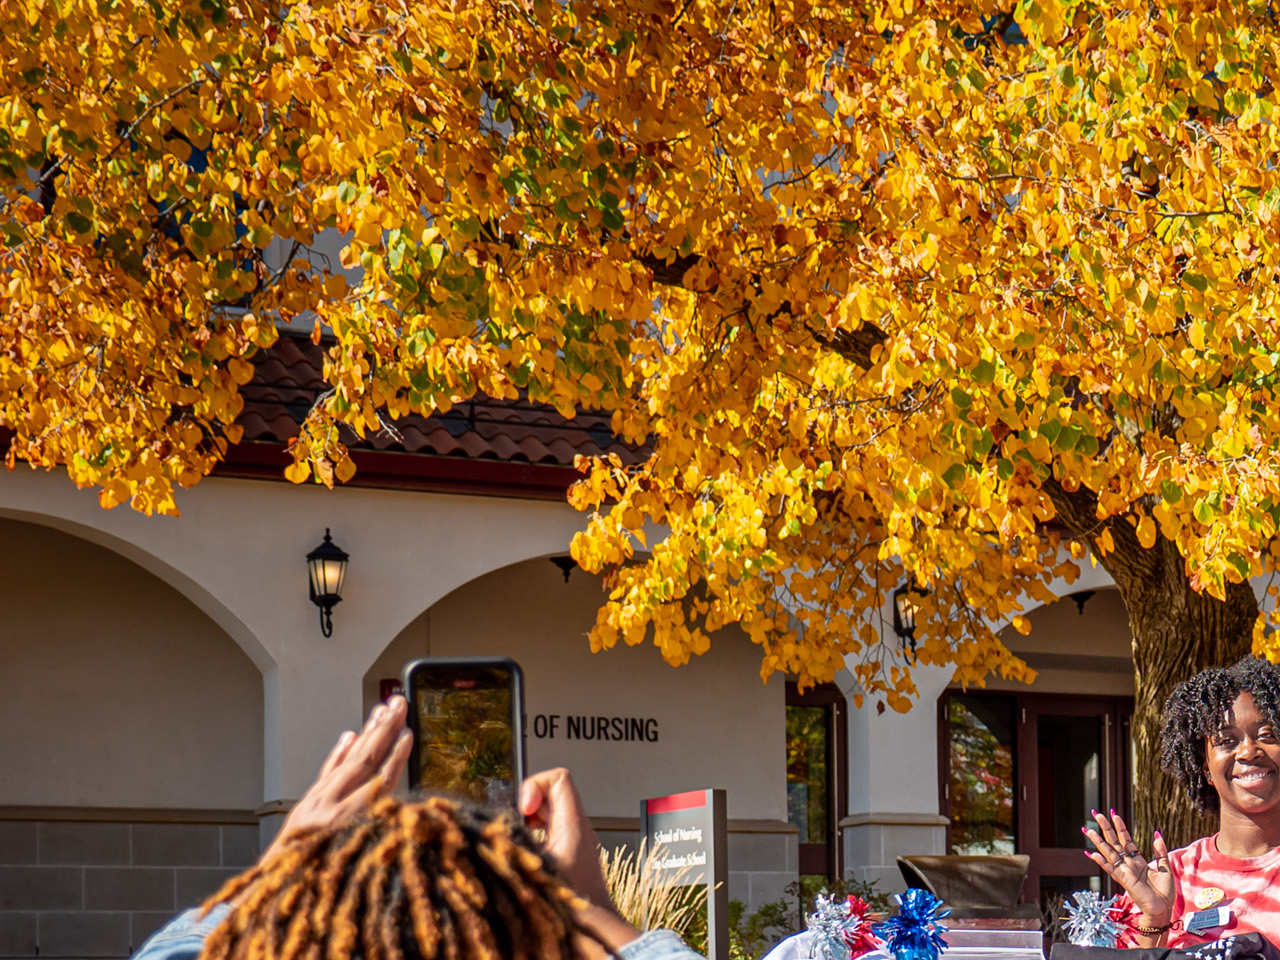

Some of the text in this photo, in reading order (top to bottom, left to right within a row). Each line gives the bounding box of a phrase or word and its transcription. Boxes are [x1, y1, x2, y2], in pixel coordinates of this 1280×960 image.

[534, 714, 560, 739] OF
[566, 715, 660, 743] NURSING
[653, 826, 702, 844] School of Nursing
[687, 850, 706, 866] School
